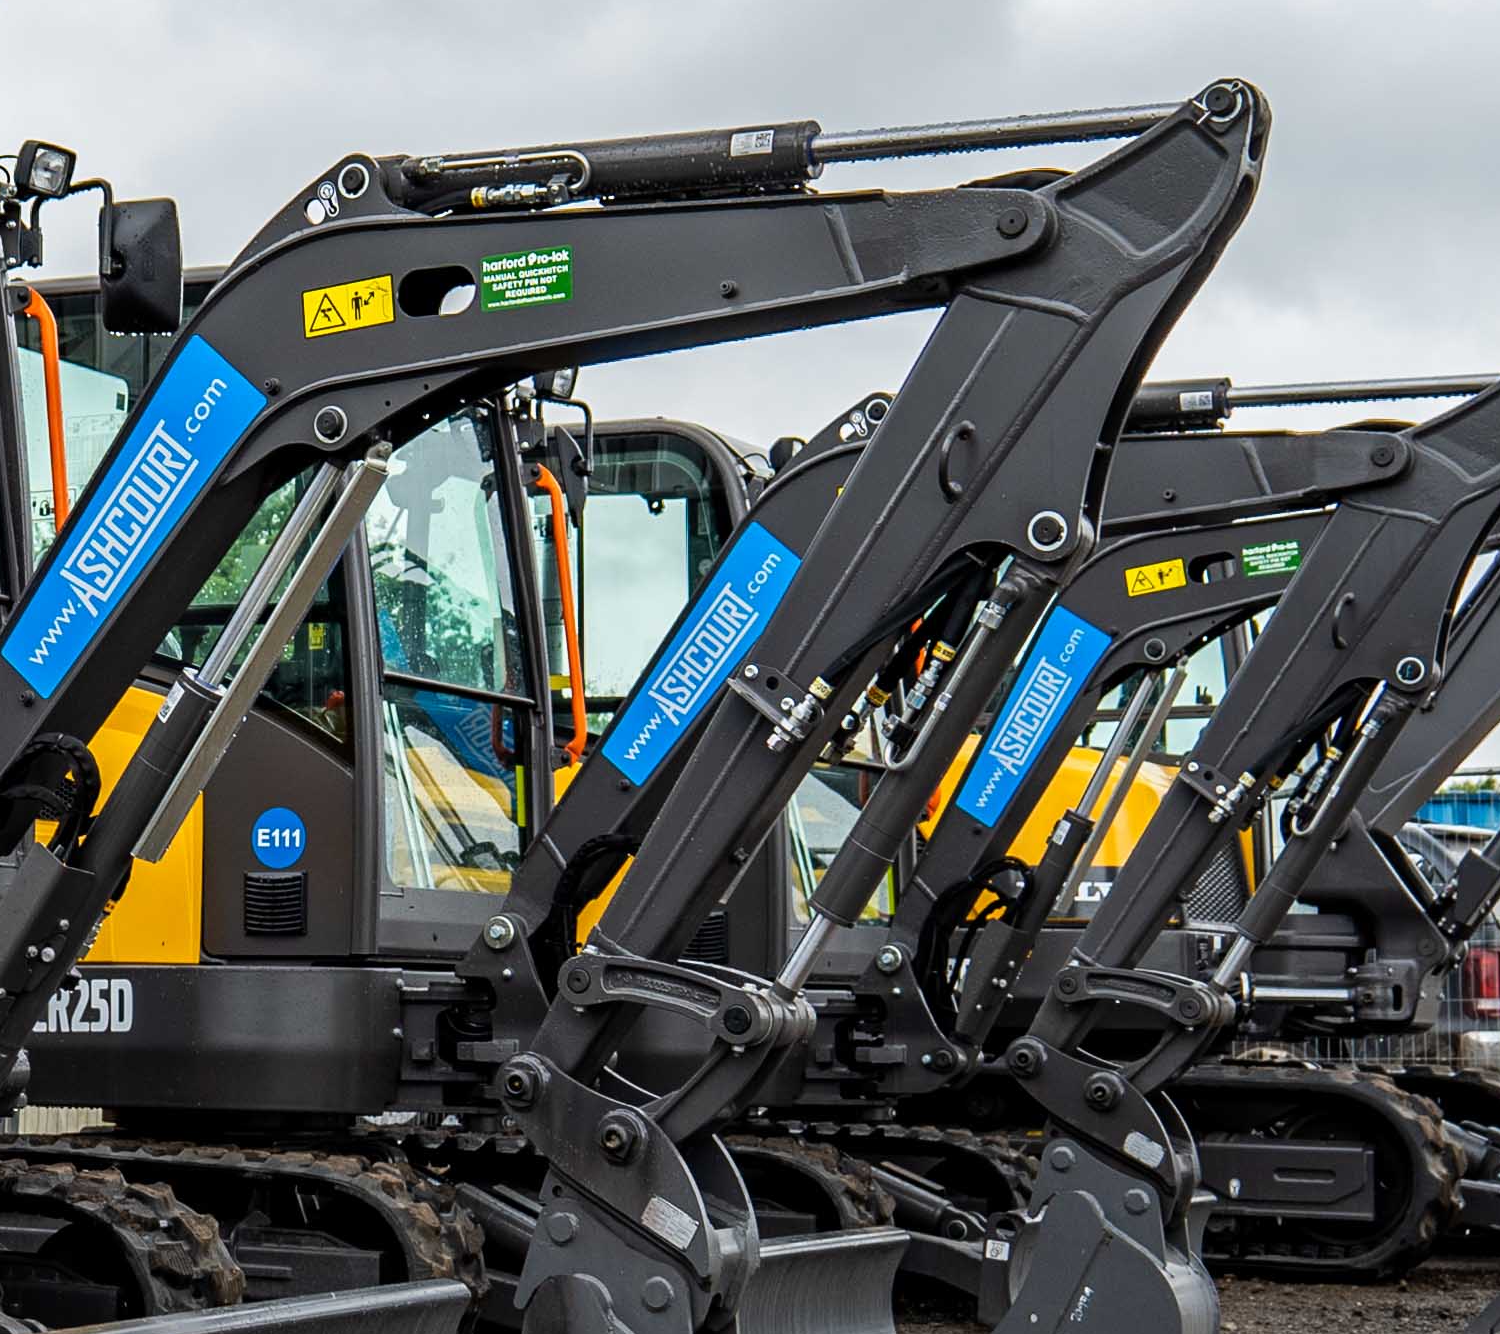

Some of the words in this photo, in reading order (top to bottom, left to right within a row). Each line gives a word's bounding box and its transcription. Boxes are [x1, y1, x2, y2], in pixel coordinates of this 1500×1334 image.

[483, 256, 526, 273] harford
[483, 272, 517, 284] MANUAL
[519, 265, 569, 278] QUICKHITCH
[492, 279, 523, 292] SAFETY
[524, 277, 539, 287] PIN
[540, 275, 558, 284] NOT
[505, 286, 547, 299] REQUIRED
[28, 377, 228, 665] www.ASHCOURT.com
[623, 553, 783, 761] www.ASHCOURT.com
[975, 628, 1085, 809] www.ASHCOURT.com
[257, 828, 301, 848] E111
